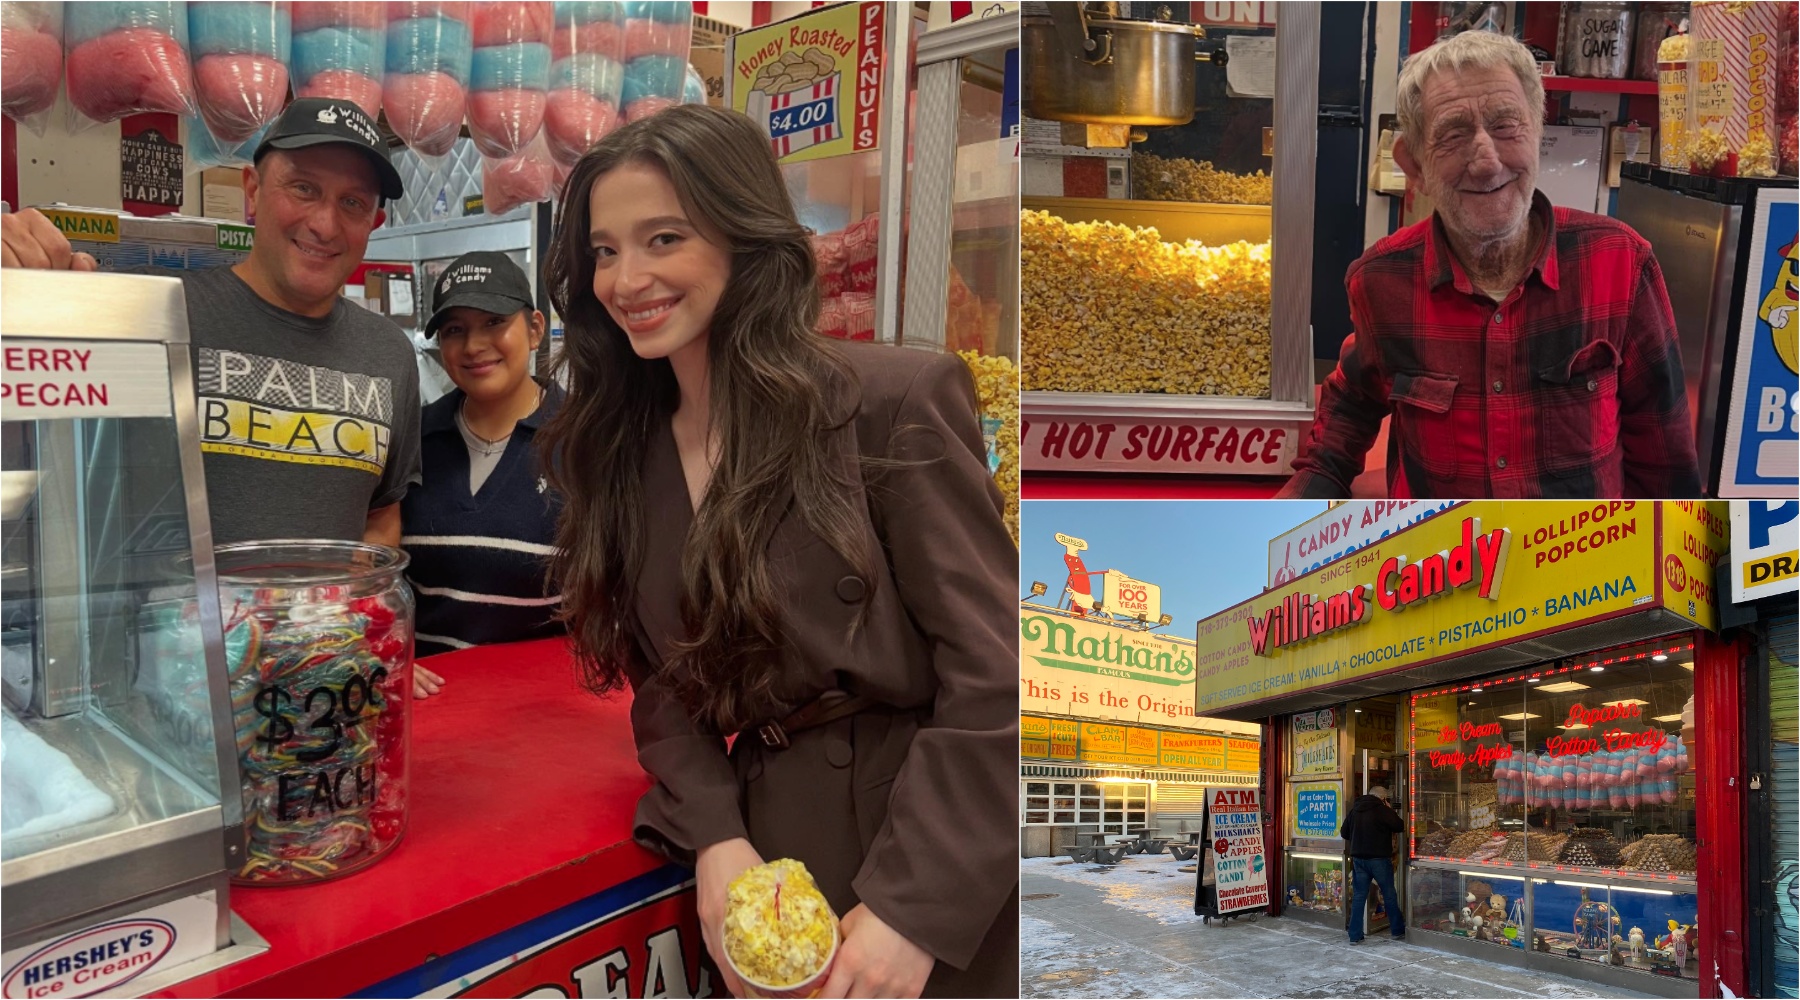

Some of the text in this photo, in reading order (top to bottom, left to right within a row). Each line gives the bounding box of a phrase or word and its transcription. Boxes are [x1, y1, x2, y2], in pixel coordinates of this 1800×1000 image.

[1583, 18, 1624, 36] SUGAR
[738, 37, 784, 80] Honey
[789, 26, 857, 58] Roasted
[1582, 38, 1619, 58] CANE
[858, 4, 881, 148] PEANUTS
[1660, 70, 1688, 85] ULAR
[1746, 32, 1768, 144] POPCORN
[771, 102, 827, 131] $4.00
[346, 118, 376, 146] Candy
[122, 146, 182, 163] HAPPINESS
[136, 164, 168, 176] COWS
[123, 184, 182, 205] HAPPY
[46, 215, 116, 235] ANANA
[1, 348, 92, 372] ERRY
[1, 383, 108, 406] PECAN
[220, 352, 384, 420] PALM
[204, 400, 389, 462] BEACH
[1040, 421, 1117, 460] HOT
[1121, 424, 1286, 464] SURFACE
[1298, 501, 1421, 558] CANDY APP
[1523, 501, 1636, 550] LOLLIPOPS
[1697, 505, 1723, 538] APPLES
[1535, 517, 1636, 569] POPCORN
[1320, 549, 1380, 584] SINCE 1941
[1667, 559, 1684, 588] 1318
[1119, 588, 1147, 602] 100
[1247, 516, 1505, 656] Williams Candy
[1118, 601, 1148, 610] YEARS
[1021, 616, 1195, 676] Nathan's
[1201, 692, 1218, 705] SOFT
[1220, 684, 1247, 701] SERVED
[1249, 681, 1262, 693] ICE
[1264, 672, 1296, 690] CREAM:
[1299, 660, 1340, 681] VANILLA
[1349, 636, 1425, 669] CHOCOLATE
[1439, 607, 1527, 646] PISTACHIO
[1545, 575, 1636, 617] BANANA
[1200, 640, 1252, 666] COTTON CANDY
[1097, 667, 1131, 678] FAMOUS
[1200, 655, 1249, 679] CANDY APPLES
[1072, 686, 1089, 704] is
[1099, 690, 1128, 708] the
[1137, 694, 1194, 717] Origin
[1356, 712, 1395, 732] CATE
[1564, 702, 1641, 730] Popcorn
[1051, 723, 1077, 732] FRESH
[1086, 725, 1119, 735] CLAM
[1438, 725, 1458, 744] Ice
[1460, 721, 1502, 741] Cream
[1101, 734, 1120, 743] BAR
[1163, 738, 1222, 748] FRANKFURTERS
[1376, 732, 1395, 746] PAR
[1546, 728, 1667, 758] Cotton Candy
[1051, 744, 1076, 756] FRIES
[1164, 754, 1187, 764] OPEN
[1188, 756, 1202, 765] ALL
[1203, 756, 1221, 766] YEAR
[1429, 743, 1513, 770] Candy Apples
[276, 763, 376, 822] EACH
[1214, 790, 1255, 804] ATM
[1309, 802, 1334, 812] PARTY
[1471, 806, 1489, 818] POP
[1215, 813, 1256, 825] ICE CREAM
[1471, 812, 1495, 829] CORN
[1214, 827, 1260, 838] MILKSHAKES
[1232, 837, 1261, 846] CANDY
[1230, 846, 1262, 857] APPLES
[1218, 859, 1247, 871] COTTON
[1219, 871, 1244, 883] CANDY
[1219, 883, 1266, 898] Chocolate Covered
[1220, 893, 1267, 911] STRAWBERRIES
[23, 928, 154, 986] HERSHEY'S
[26, 950, 152, 999] Ice Cream
